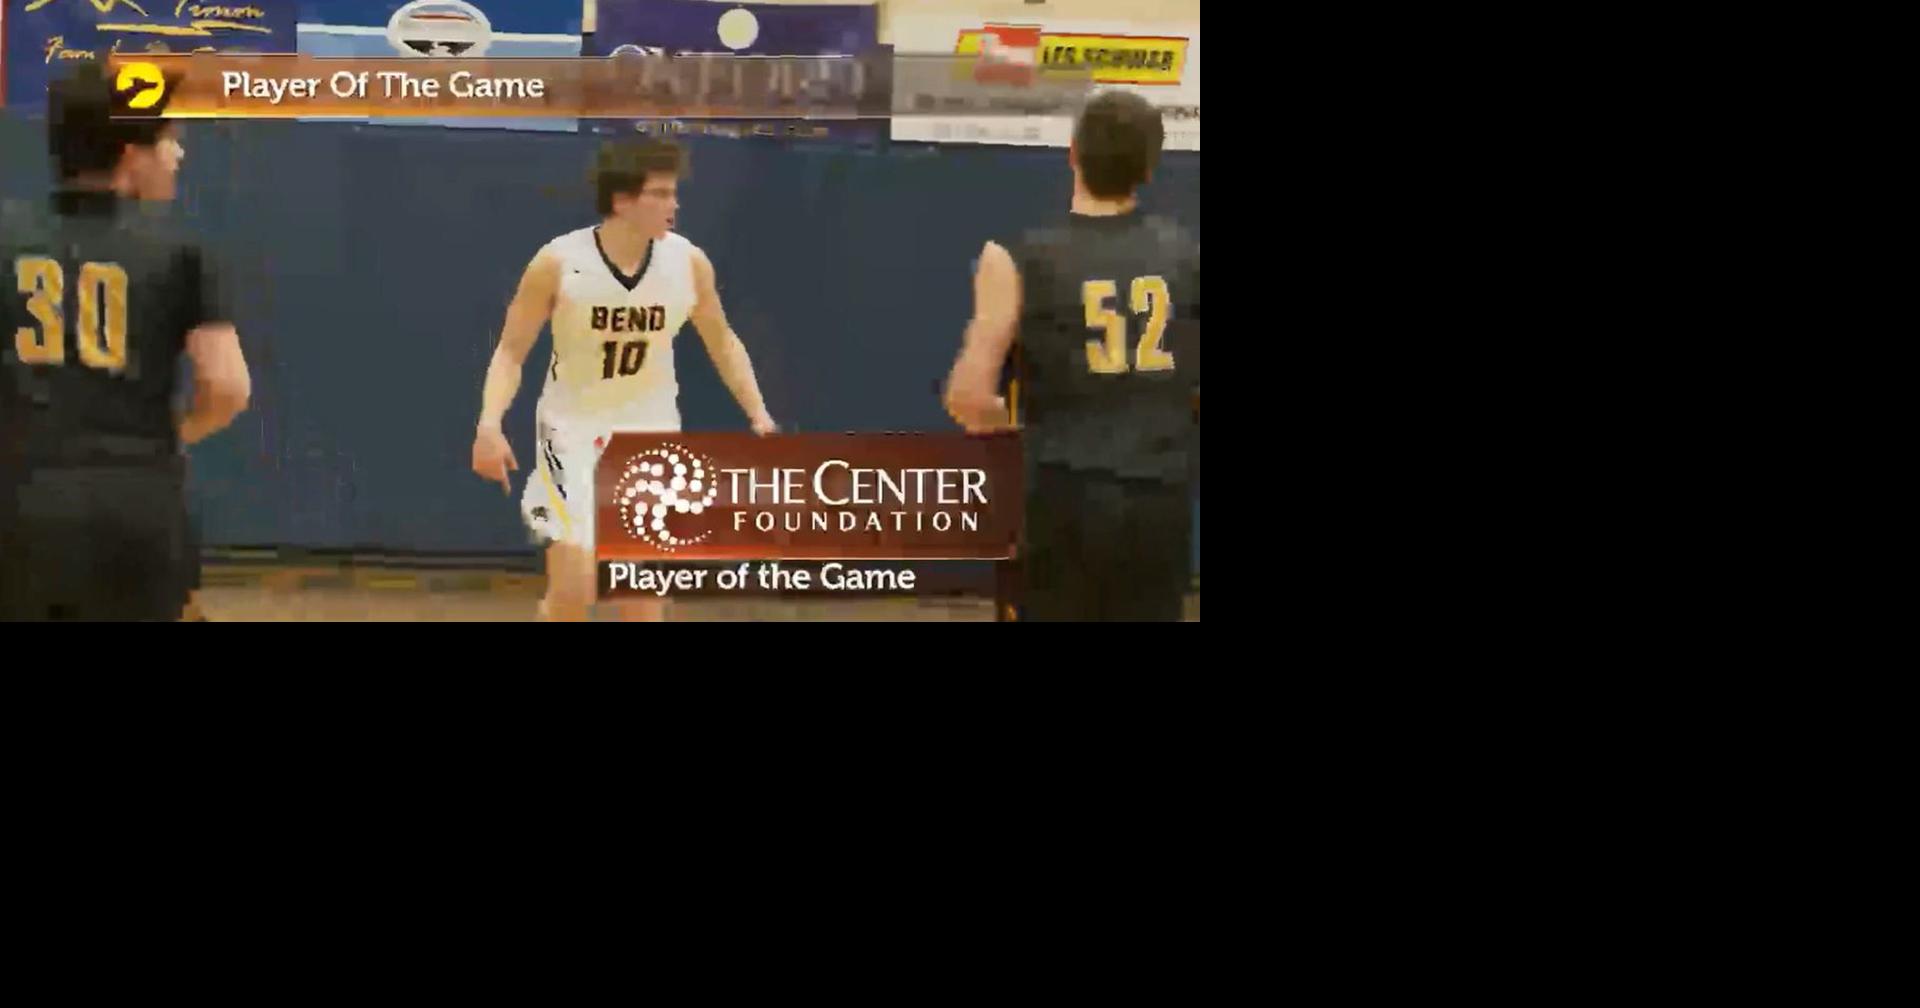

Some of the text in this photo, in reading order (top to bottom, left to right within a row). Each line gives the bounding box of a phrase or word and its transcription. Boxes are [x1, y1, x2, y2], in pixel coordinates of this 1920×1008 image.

[15, 256, 128, 369] 30
[591, 305, 665, 332] BEND
[1083, 275, 1175, 373] 52
[602, 340, 649, 379] 10
